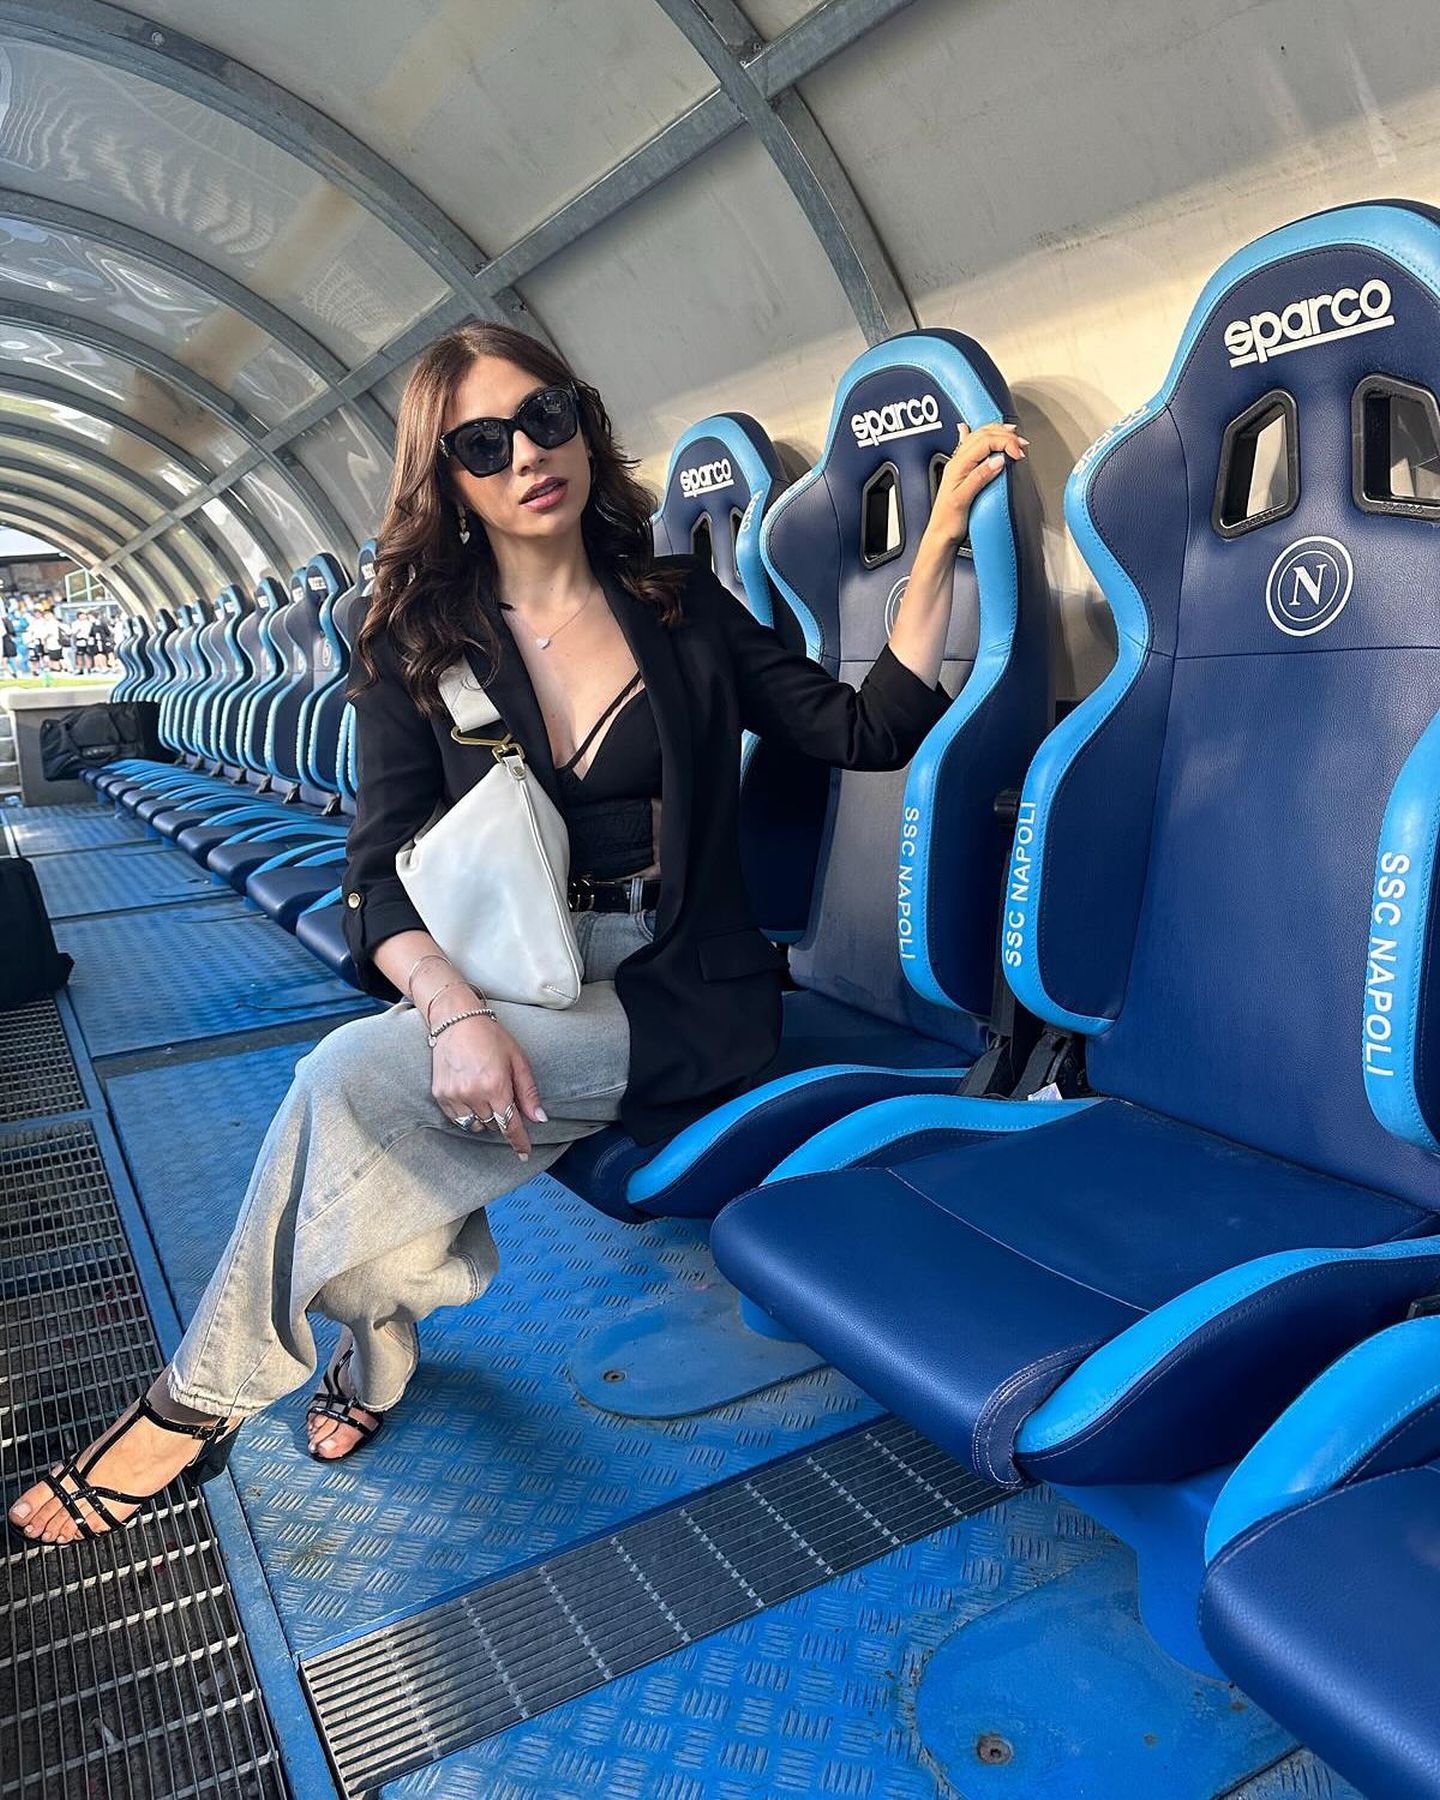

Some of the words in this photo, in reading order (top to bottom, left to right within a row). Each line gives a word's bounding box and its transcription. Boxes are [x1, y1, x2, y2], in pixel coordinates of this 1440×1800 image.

[1224, 279, 1393, 364] sparco
[851, 394, 941, 446] sparco
[680, 458, 733, 497] sparco
[1289, 564, 1327, 605] N
[902, 807, 919, 857] SSC
[1010, 802, 1036, 901] NAPOLI
[898, 865, 916, 959] NAPOLI
[1374, 852, 1410, 926] SSC
[1005, 911, 1025, 967] SSC
[1366, 936, 1397, 1077] NAPOLI
